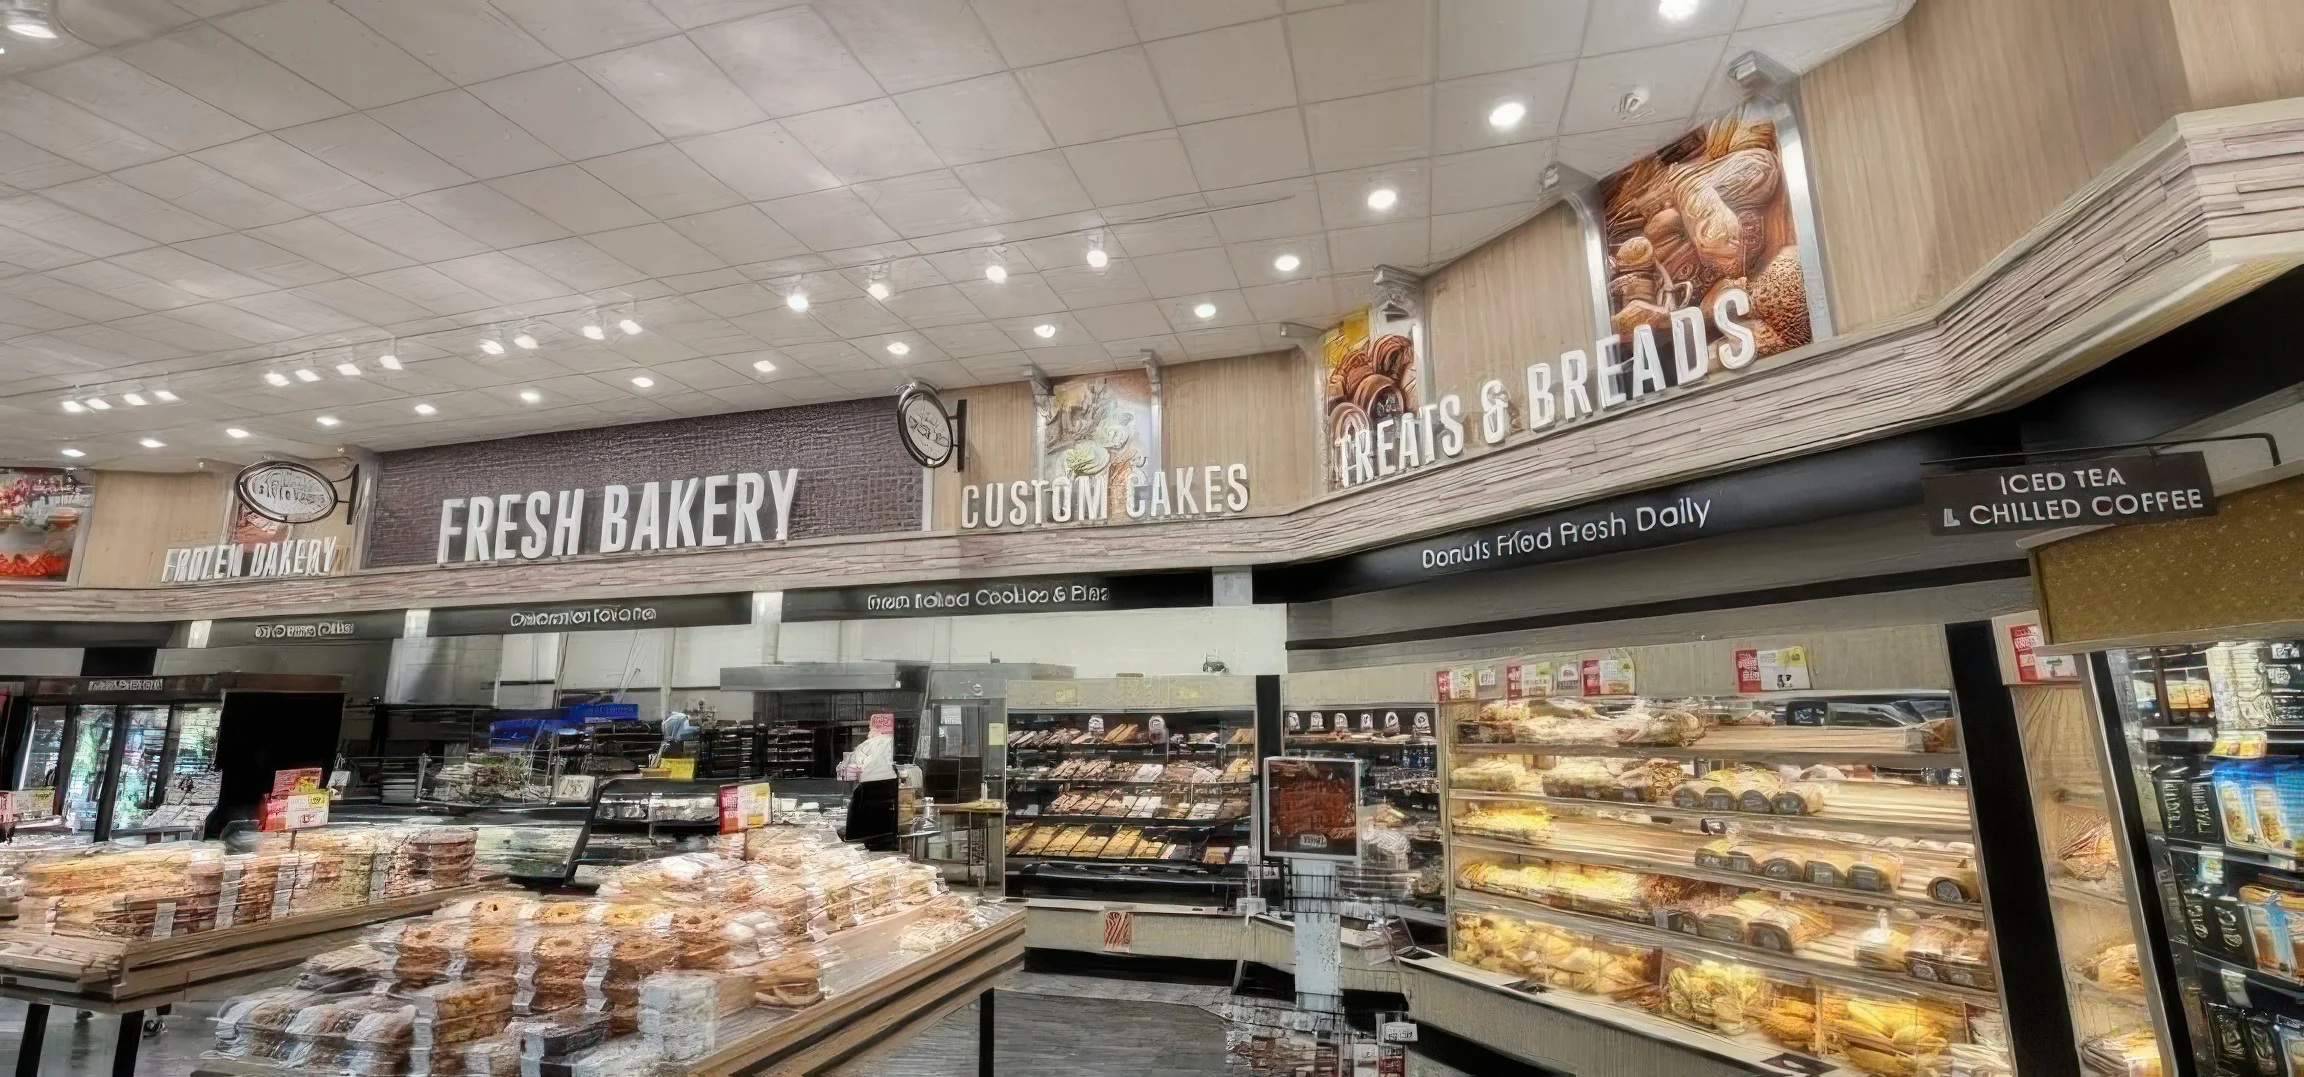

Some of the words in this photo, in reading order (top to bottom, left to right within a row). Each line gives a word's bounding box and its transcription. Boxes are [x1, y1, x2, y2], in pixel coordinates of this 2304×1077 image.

[1335, 394, 1463, 487] TREATS
[1481, 379, 1509, 444] &
[1527, 288, 1756, 432] BREADS
[961, 475, 1108, 529] CUSTOM
[1126, 463, 1249, 519] CAKES
[1969, 498, 2081, 525] CHILLED
[2092, 488, 2204, 516] COFFEE
[2000, 472, 2066, 496] ICED
[2074, 467, 2126, 488] TEA
[436, 488, 584, 563] FRESH
[600, 468, 799, 553] BAKERY
[1422, 540, 1489, 569] Donuts
